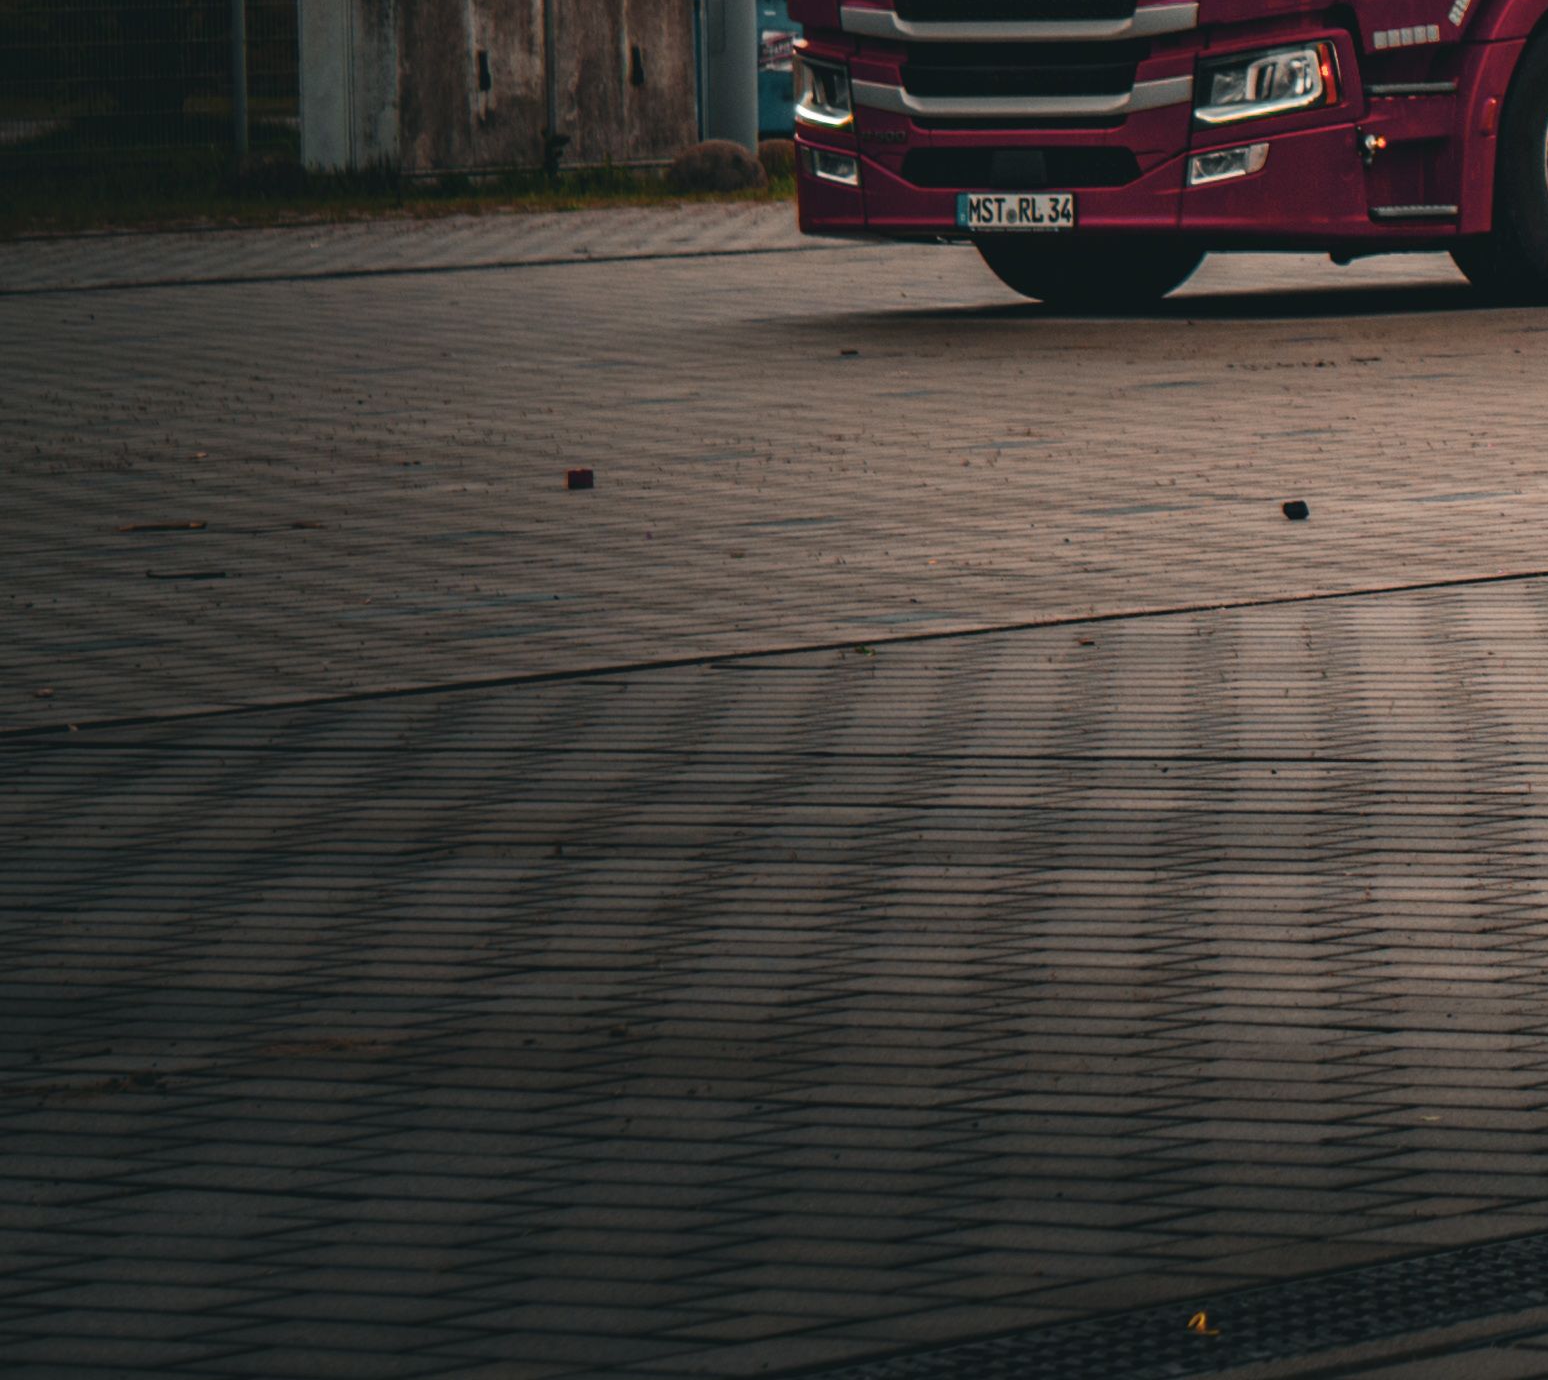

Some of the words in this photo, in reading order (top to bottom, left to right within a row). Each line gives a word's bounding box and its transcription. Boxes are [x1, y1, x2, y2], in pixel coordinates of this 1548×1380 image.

[969, 198, 1006, 223] MST
[1019, 198, 1044, 223] RL
[1049, 198, 1072, 223] 34
